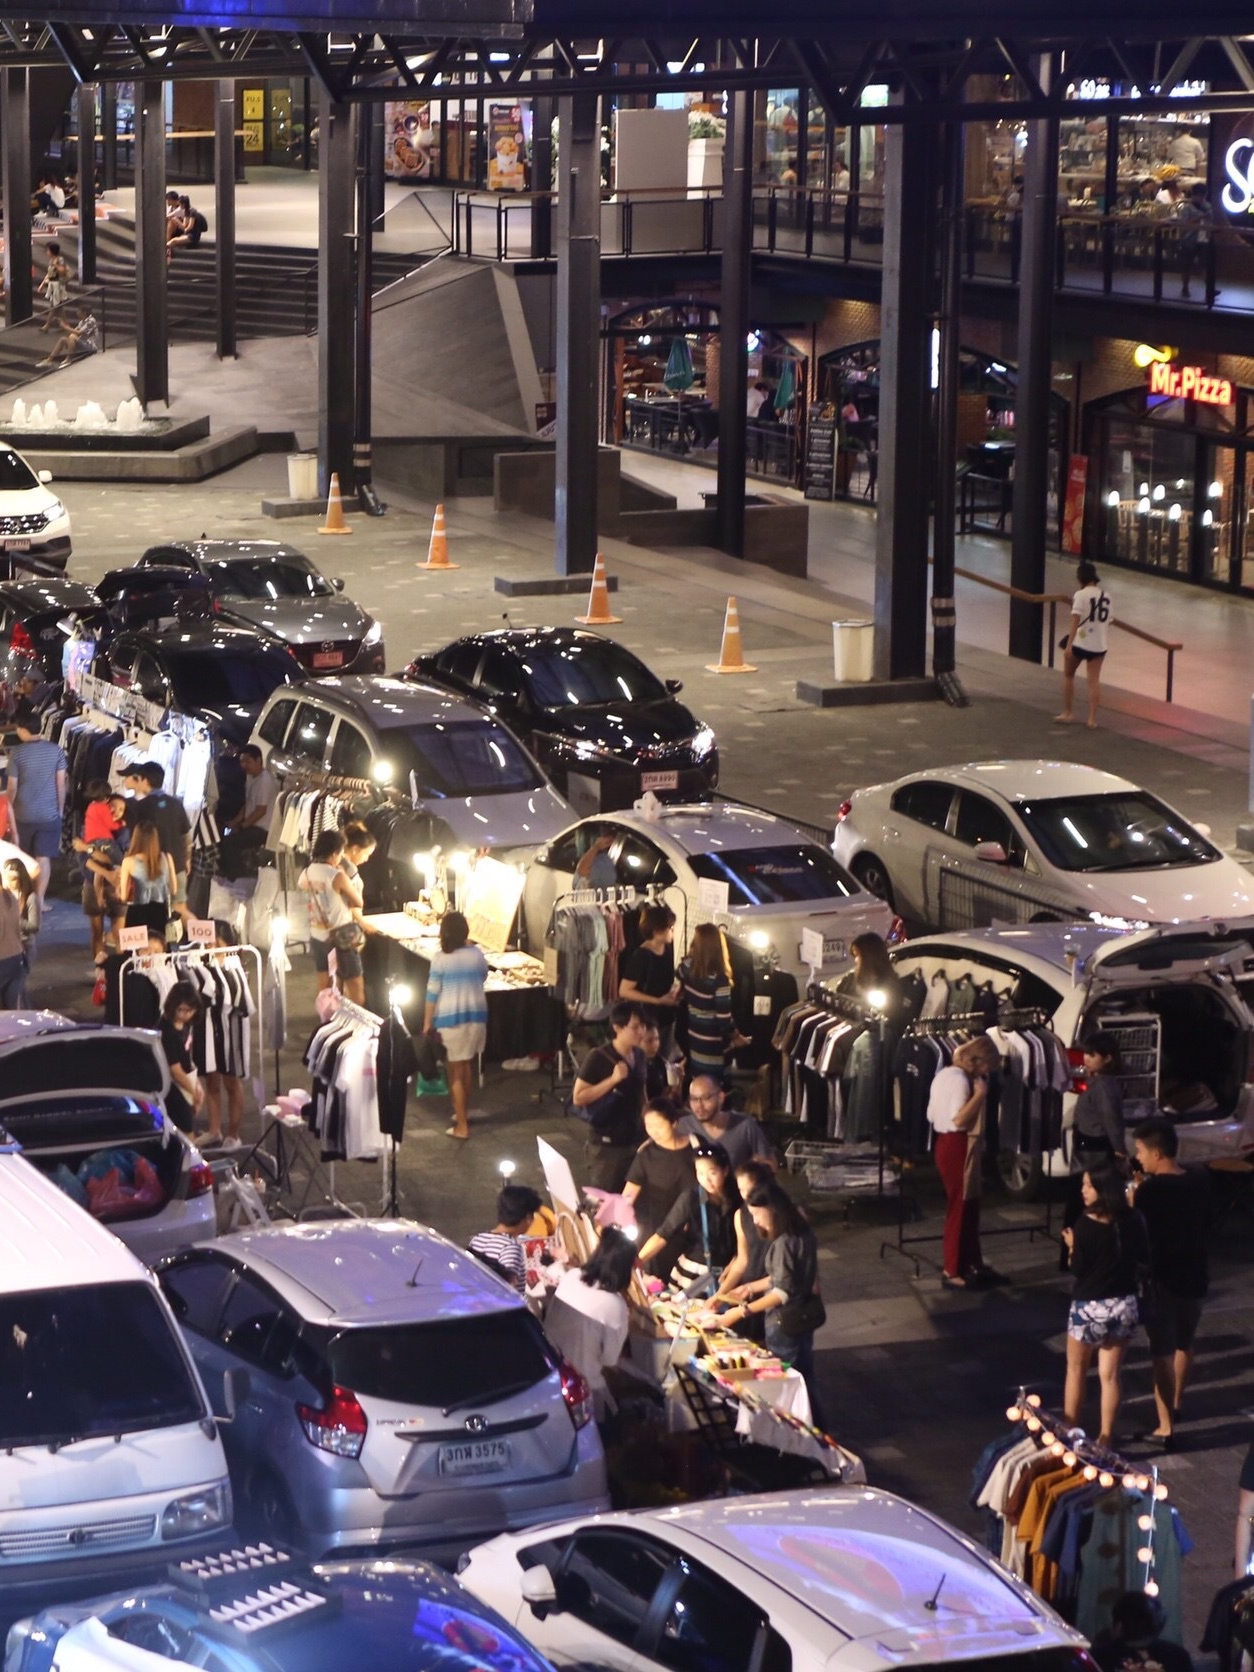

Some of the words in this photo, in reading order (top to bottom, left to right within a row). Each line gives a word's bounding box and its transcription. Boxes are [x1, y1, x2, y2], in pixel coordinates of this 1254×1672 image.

[1089, 597, 1111, 623] 16
[121, 932, 145, 944] SALE
[191, 926, 212, 937] 100
[475, 1442, 505, 1458] 3575
